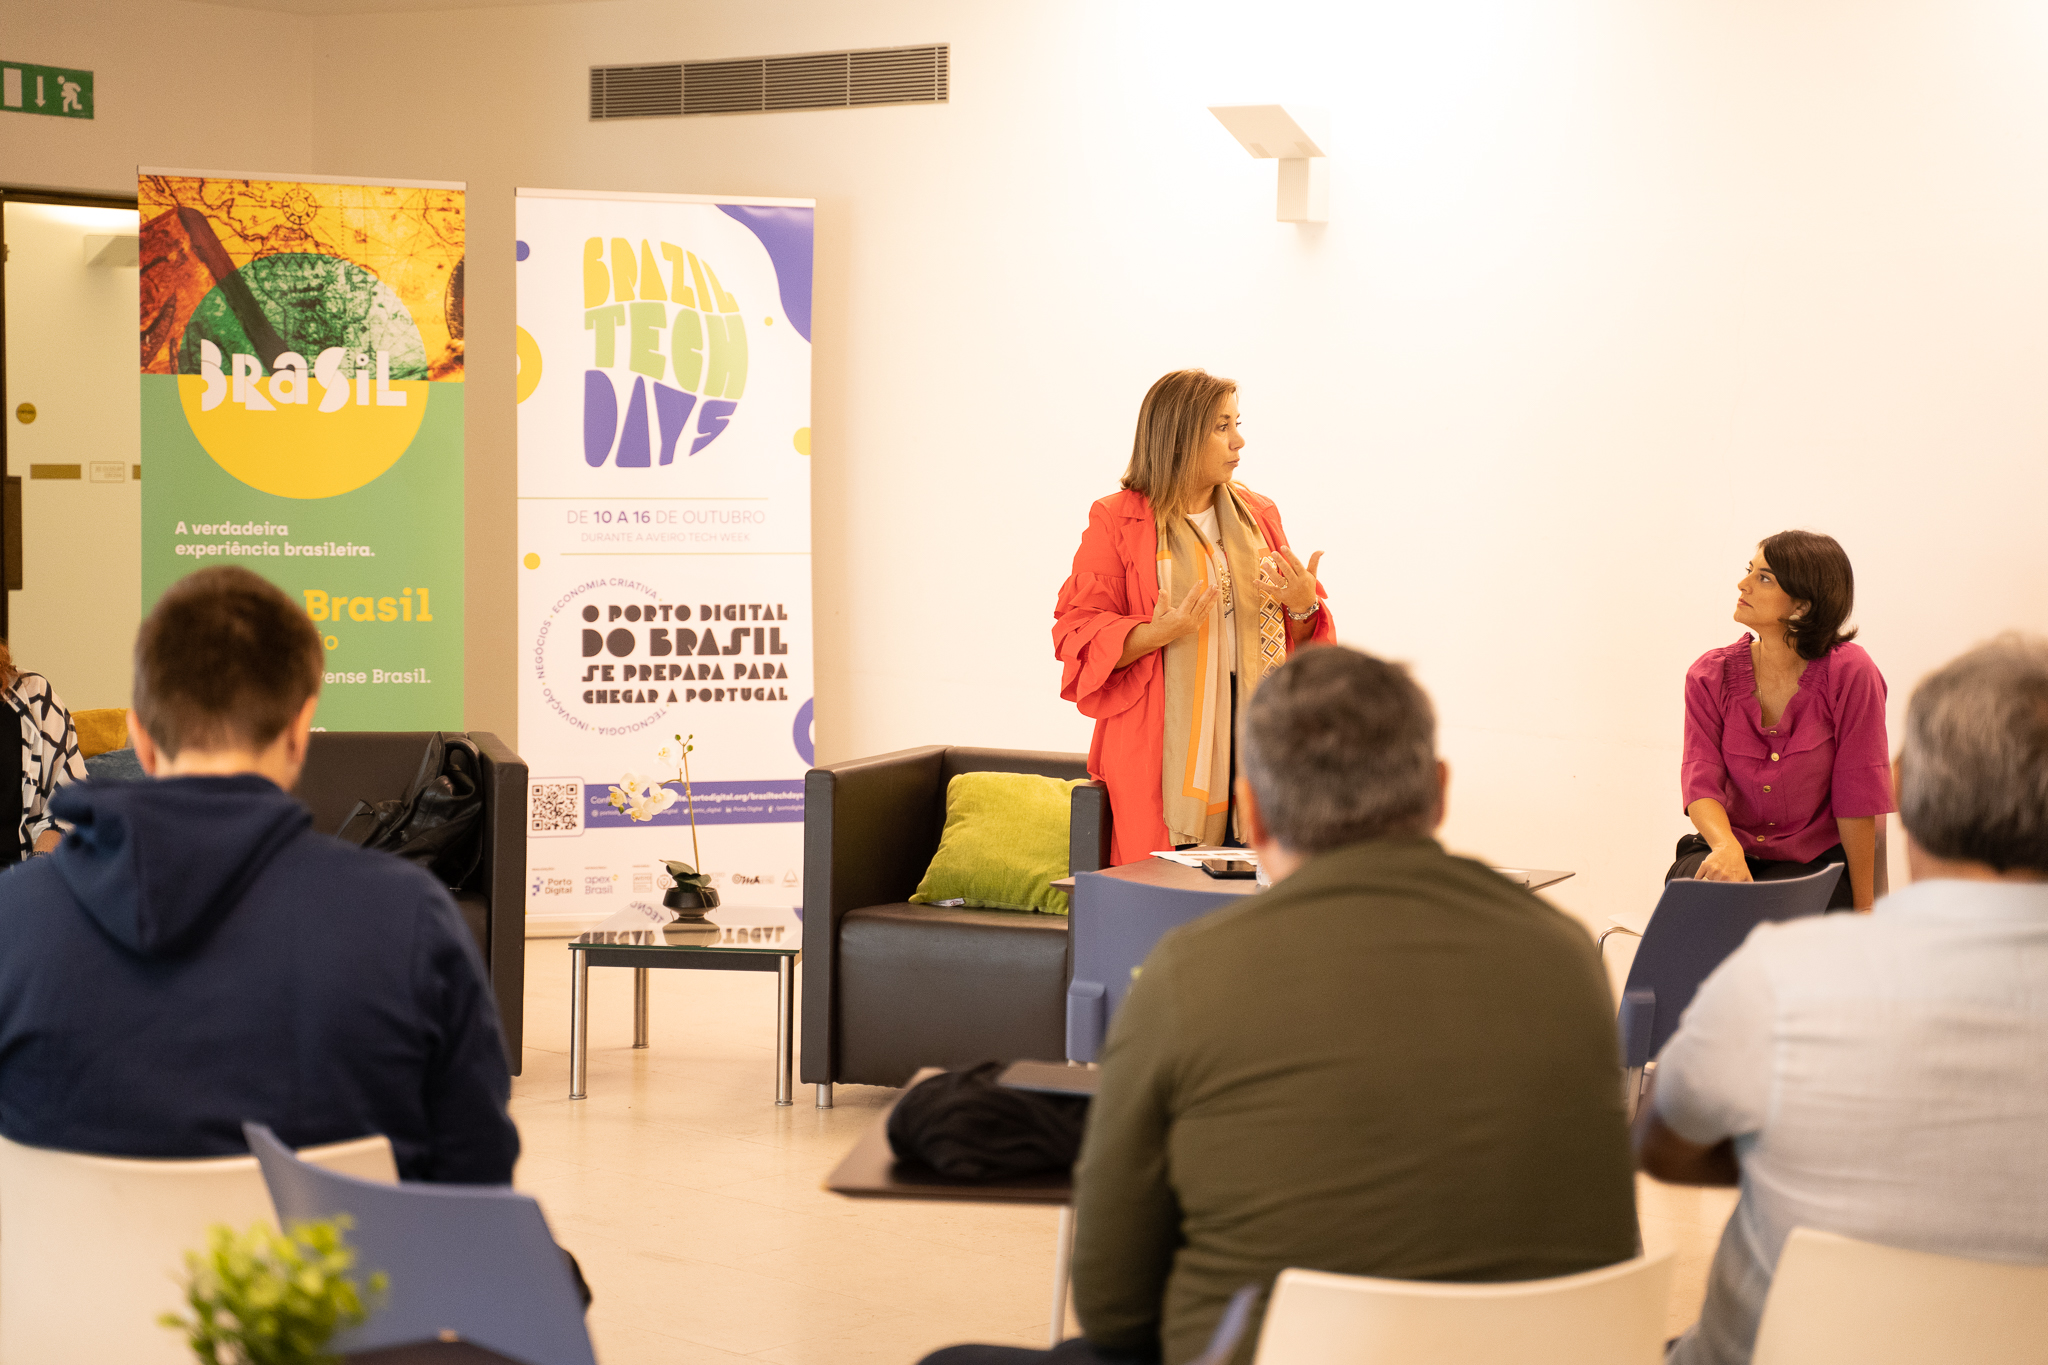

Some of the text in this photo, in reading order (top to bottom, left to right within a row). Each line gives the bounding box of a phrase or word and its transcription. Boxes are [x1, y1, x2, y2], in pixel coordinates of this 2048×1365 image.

[583, 237, 740, 313] BRAZIL
[584, 302, 749, 400] TECH
[583, 369, 738, 468] DAYS
[567, 510, 766, 524] DE 10 A 16 DE OUTUBRO
[174, 521, 289, 536] A verdadeira
[581, 532, 750, 542] DURANTE A AVEIRO TECH WEEK
[175, 541, 375, 559] experiência brasileira.
[303, 587, 433, 622] Brasil
[552, 578, 657, 614] ECONOMIA CRIATIVA
[582, 604, 788, 623] O PORTO DIGITAL
[533, 620, 551, 679] NEGÓCIOS
[582, 627, 788, 658] DO BRASIL
[321, 668, 432, 684] ense Brasil.
[582, 662, 788, 682] SE PREPARA PARA
[582, 687, 788, 704] CHEGAR A PORTUGAL
[543, 688, 589, 731] INOVAÇÃO
[598, 708, 666, 735] TECNOLOGIA
[547, 878, 572, 886] Porto
[585, 876, 610, 885] apex
[585, 885, 613, 895] Brasil
[544, 886, 572, 896] Digital
